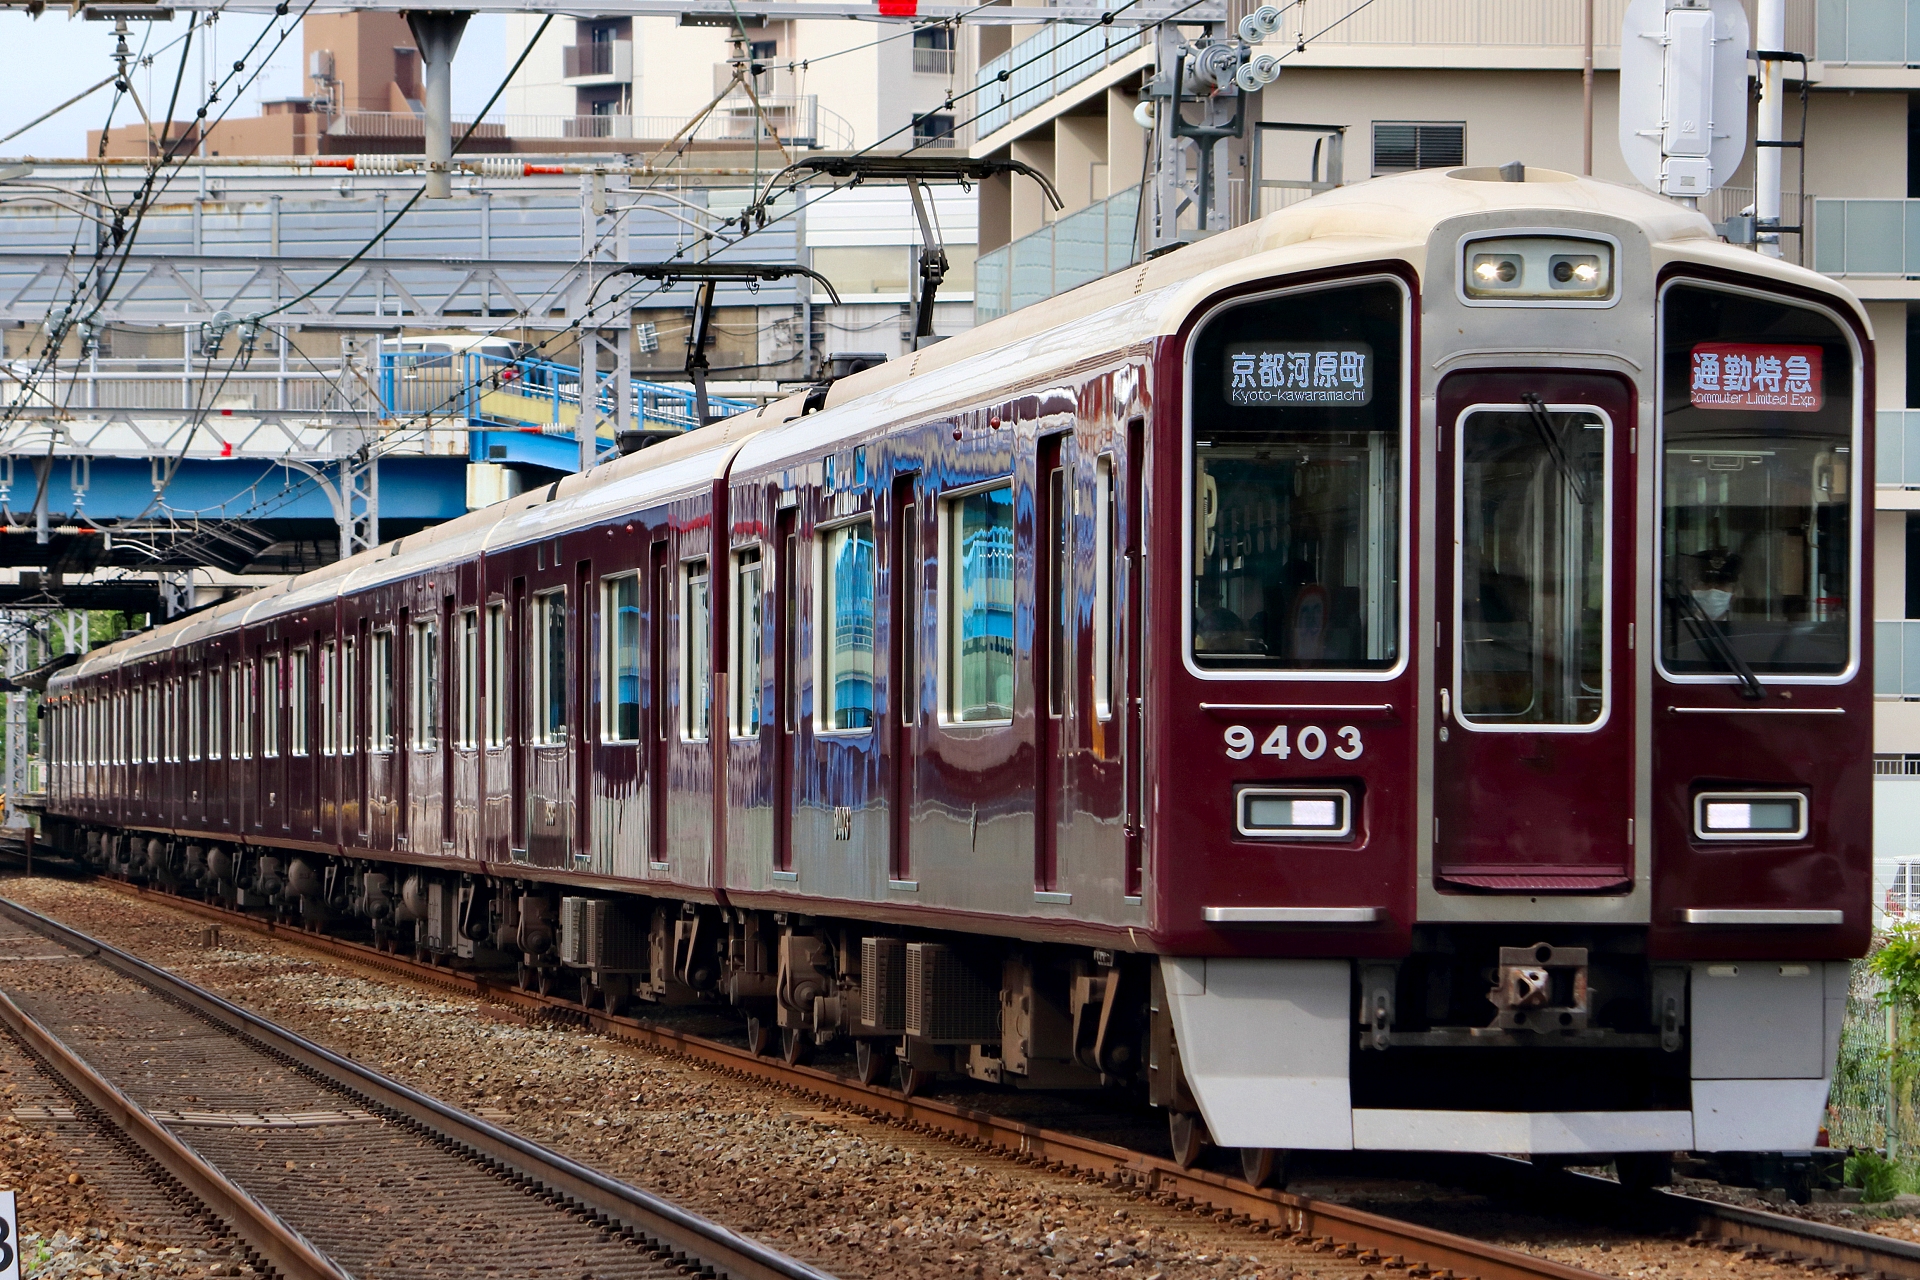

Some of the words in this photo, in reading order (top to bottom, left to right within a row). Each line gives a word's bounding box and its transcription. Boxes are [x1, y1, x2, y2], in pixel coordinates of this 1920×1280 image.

[1231, 351, 1366, 388] 京都河原町
[1692, 353, 1812, 393] 通勤特急
[1746, 393, 1788, 405] Limited
[1224, 725, 1364, 760] 9403
